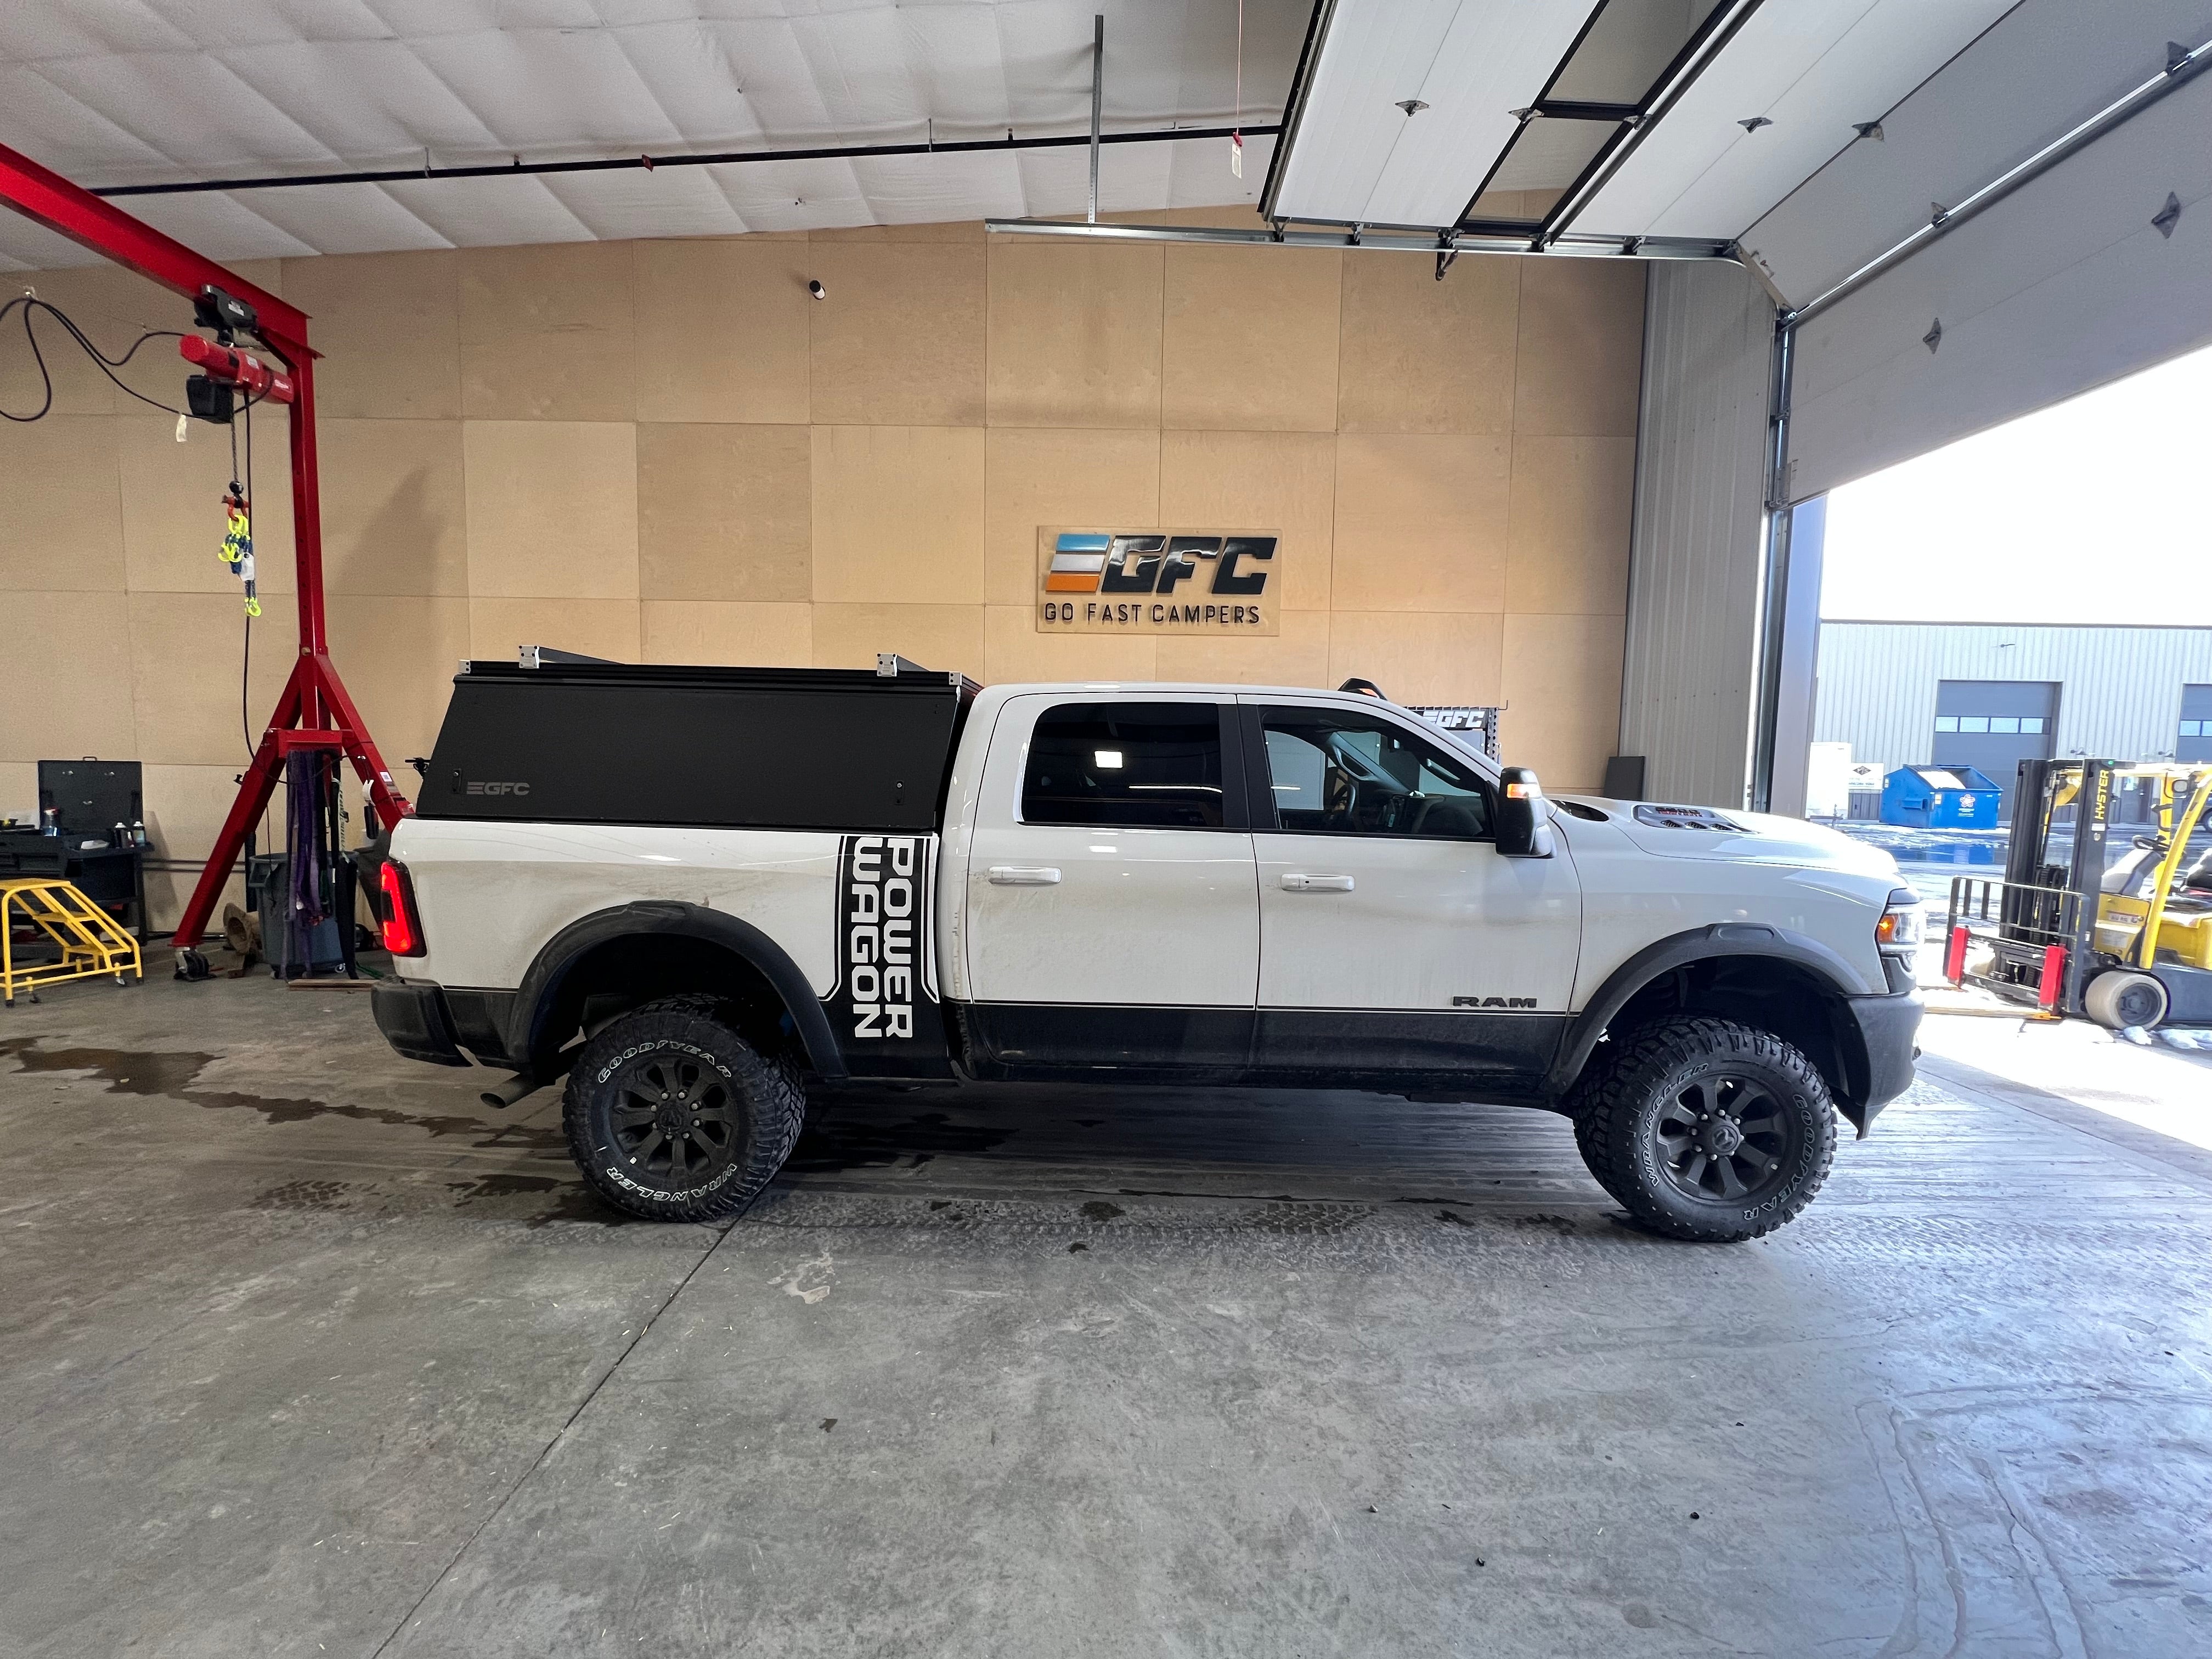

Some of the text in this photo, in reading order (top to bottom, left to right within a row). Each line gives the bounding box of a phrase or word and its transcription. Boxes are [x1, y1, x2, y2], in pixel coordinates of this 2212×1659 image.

[1101, 535, 1277, 594] GFC
[1045, 603, 1260, 624] GO FAST CAMPERS
[484, 782, 530, 795] GFC
[2095, 769, 2109, 820] HYSTER
[851, 837, 883, 1038] WAGON
[883, 838, 915, 1038] POWER
[1453, 996, 1537, 1008] RAM
[598, 1040, 732, 1084] GOODYEAR
[1641, 1063, 1709, 1187] WRANGLER
[606, 1163, 738, 1201] WRANGLER
[1743, 1094, 1815, 1221] GOODYEAR
